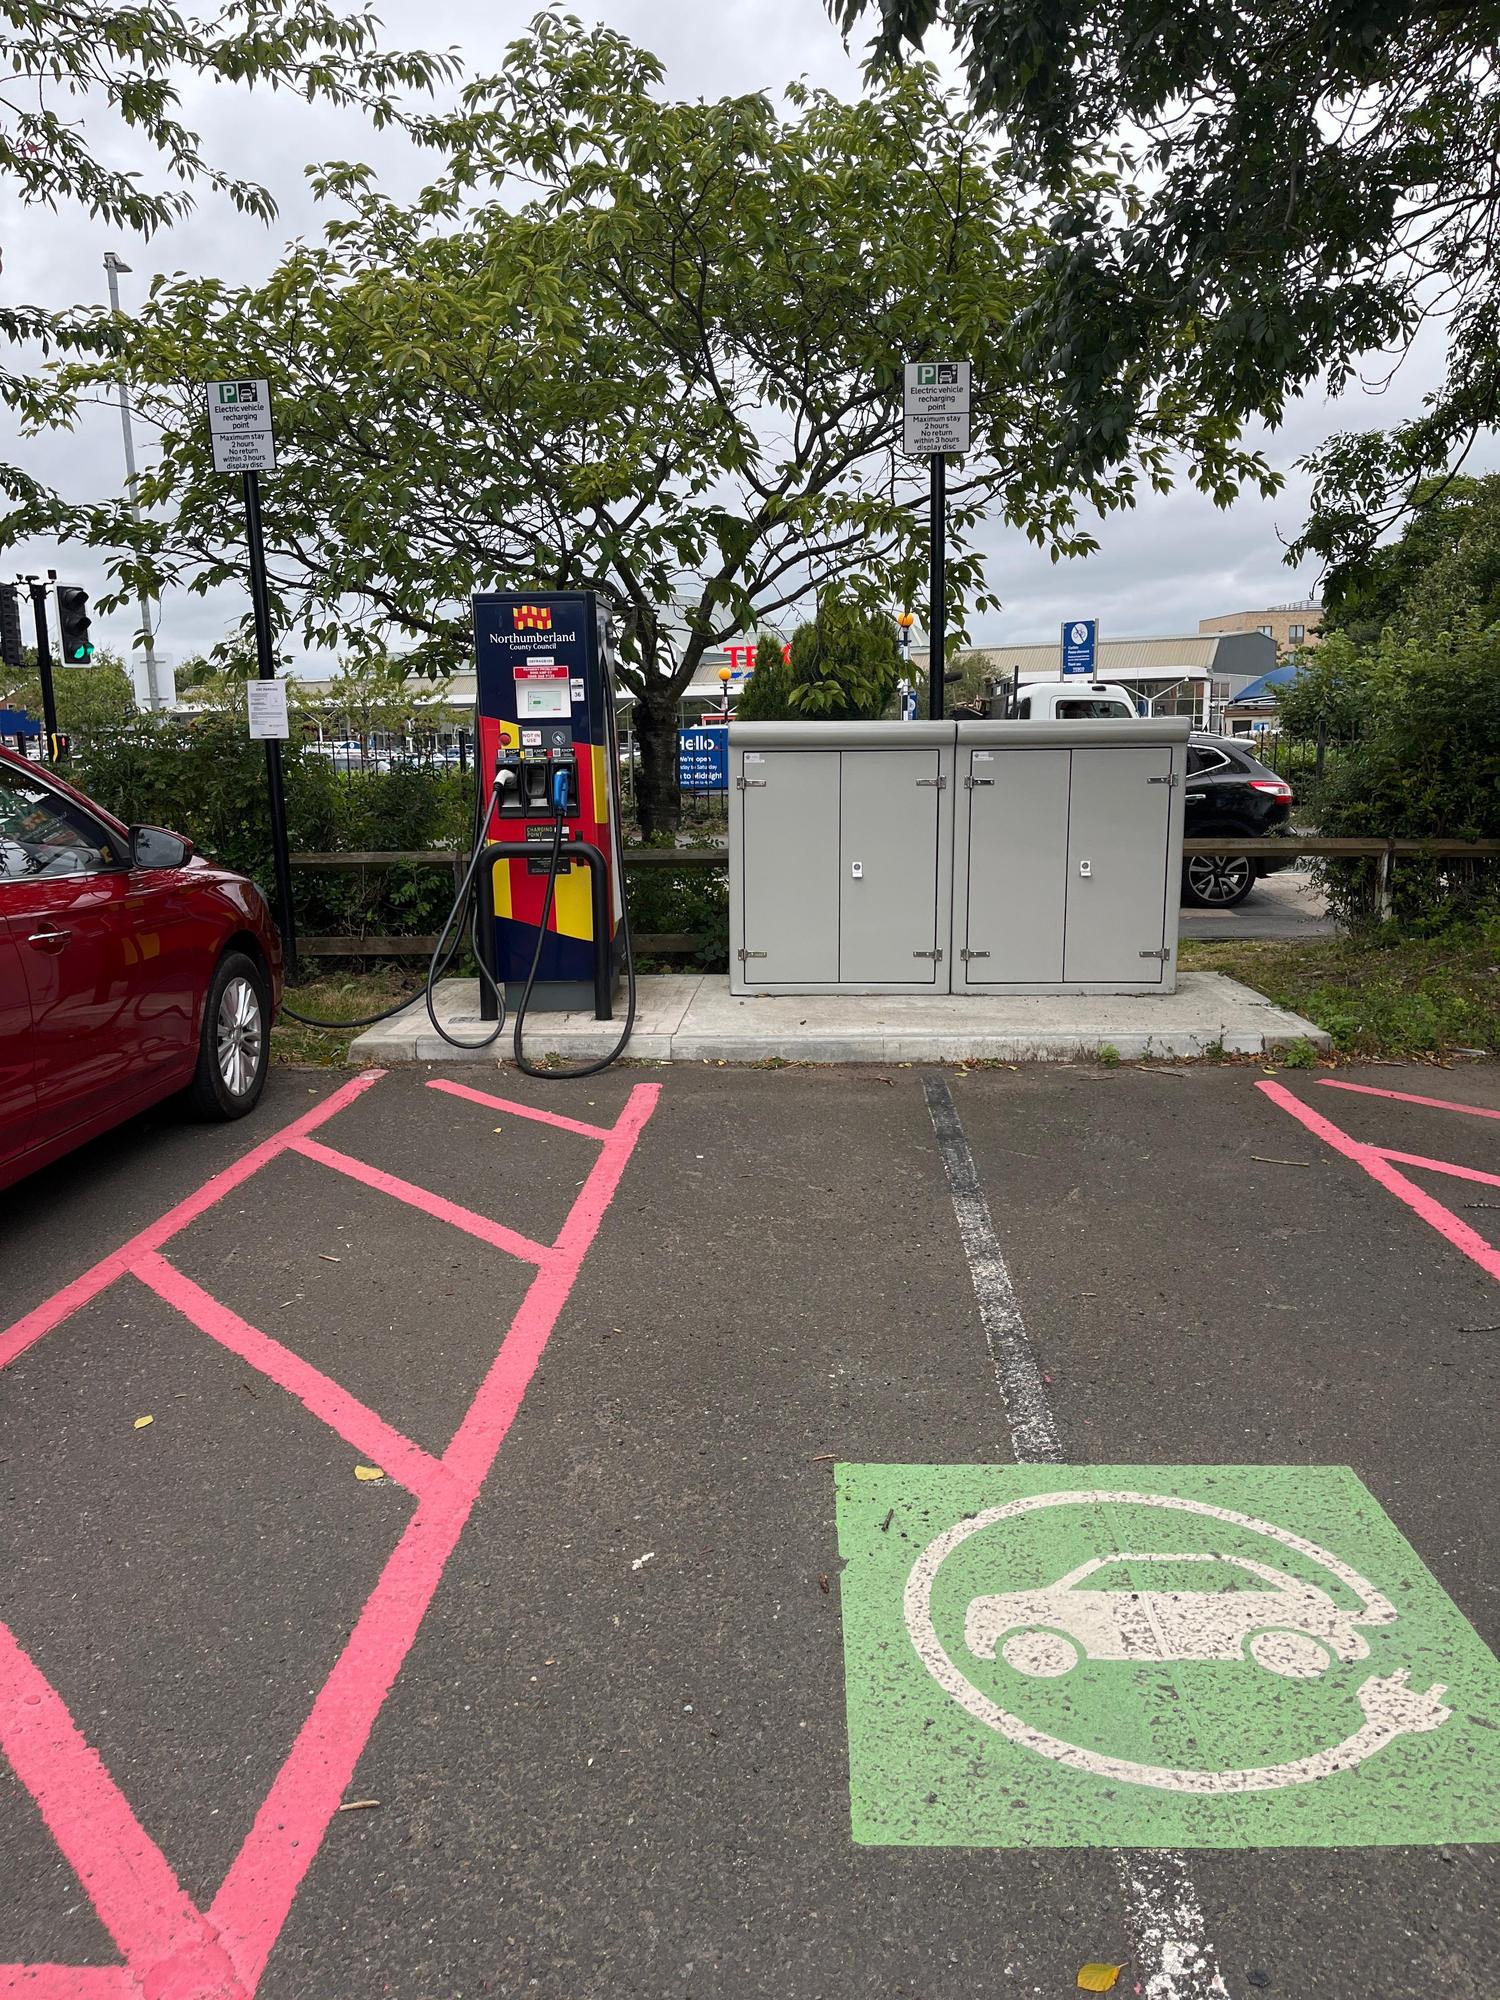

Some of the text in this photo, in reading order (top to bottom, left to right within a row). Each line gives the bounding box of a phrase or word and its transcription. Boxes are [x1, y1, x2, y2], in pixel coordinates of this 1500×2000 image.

[922, 367, 934, 384] P
[222, 385, 235, 402] P
[910, 387, 938, 395] Electric
[918, 395, 956, 403] recharging
[214, 404, 264, 413] Electric vehicle
[927, 404, 946, 412] point
[223, 413, 258, 423] recharging
[232, 421, 250, 430] point
[250, 433, 265, 441] stay
[236, 440, 255, 448] hours
[917, 444, 941, 452] display
[223, 455, 242, 463] within
[226, 461, 249, 470] display
[489, 631, 576, 644] Northumberland
[509, 642, 557, 651] County Council
